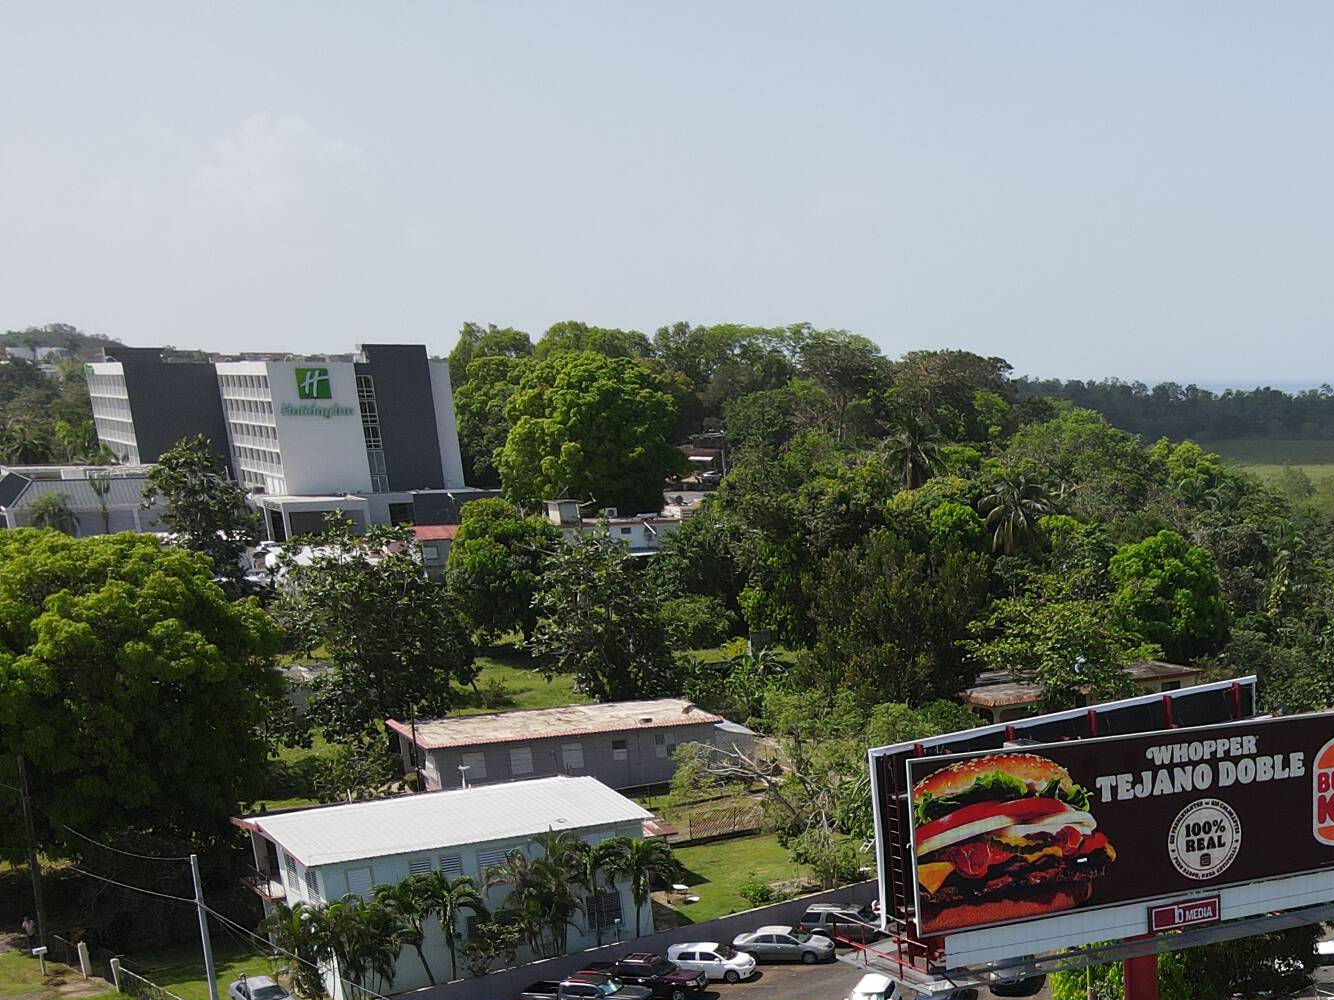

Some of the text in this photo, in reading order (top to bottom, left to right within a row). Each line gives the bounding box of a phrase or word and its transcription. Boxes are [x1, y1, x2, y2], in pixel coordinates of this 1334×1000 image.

[1145, 735, 1257, 765] WHOPPER
[1095, 752, 1305, 803] TEJANO DOBLE
[1185, 819, 1226, 838] 100%
[1185, 835, 1226, 853] REAL
[1185, 906, 1213, 920] MEDIA
